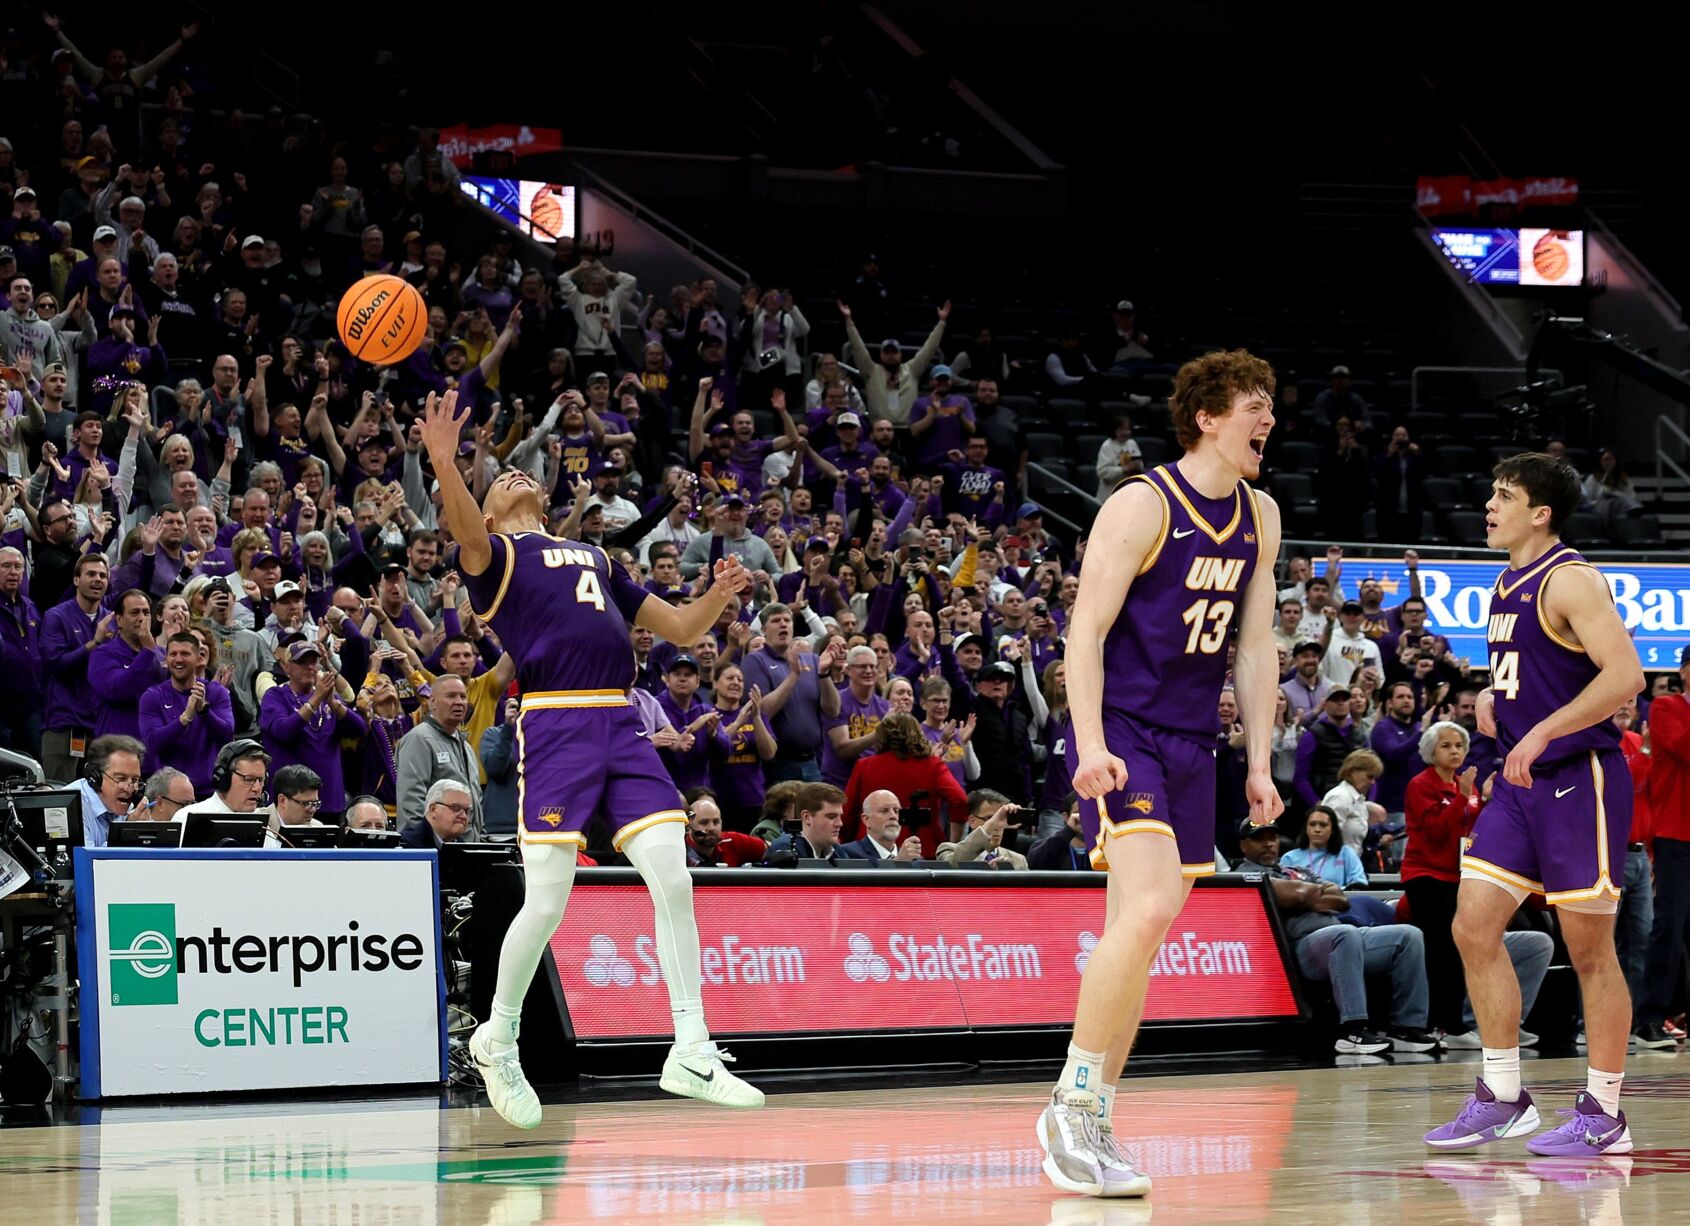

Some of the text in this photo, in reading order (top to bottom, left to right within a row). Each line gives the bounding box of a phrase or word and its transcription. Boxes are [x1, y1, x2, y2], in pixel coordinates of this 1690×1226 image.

[348, 290, 390, 341] Wilson
[541, 548, 596, 569] UNI
[1184, 556, 1247, 592] UNI
[575, 569, 606, 612] 4
[1181, 598, 1235, 654] 13
[1487, 613, 1519, 643] UNI
[109, 920, 424, 988] enterprise
[634, 934, 807, 986] SeFarm
[888, 932, 1043, 981] StateFarm
[194, 1006, 350, 1048] CENTER
